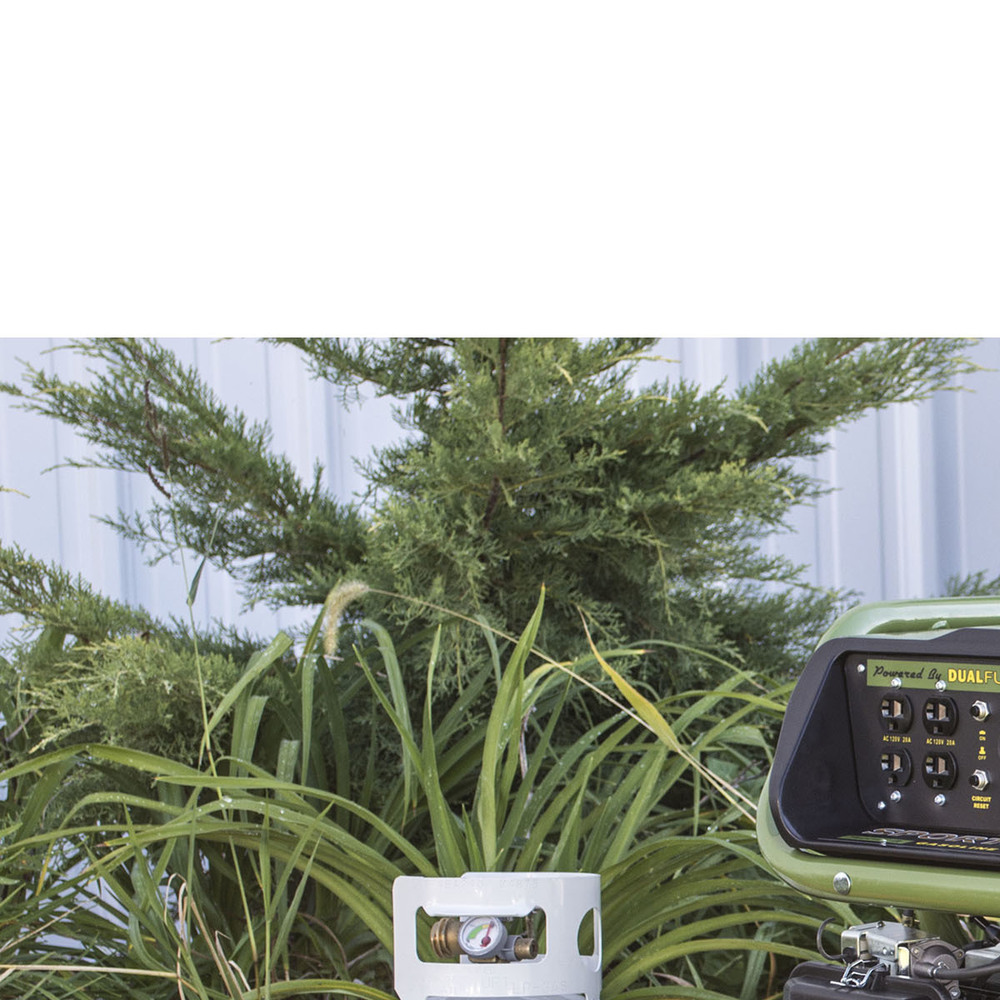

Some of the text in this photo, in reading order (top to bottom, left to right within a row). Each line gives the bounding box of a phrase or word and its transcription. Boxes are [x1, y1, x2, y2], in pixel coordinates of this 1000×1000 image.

[873, 666, 924, 681] Powered
[927, 668, 943, 681] By
[882, 735, 889, 743] AC
[971, 795, 992, 803] CIRCUIT
[973, 802, 990, 810] RESET
